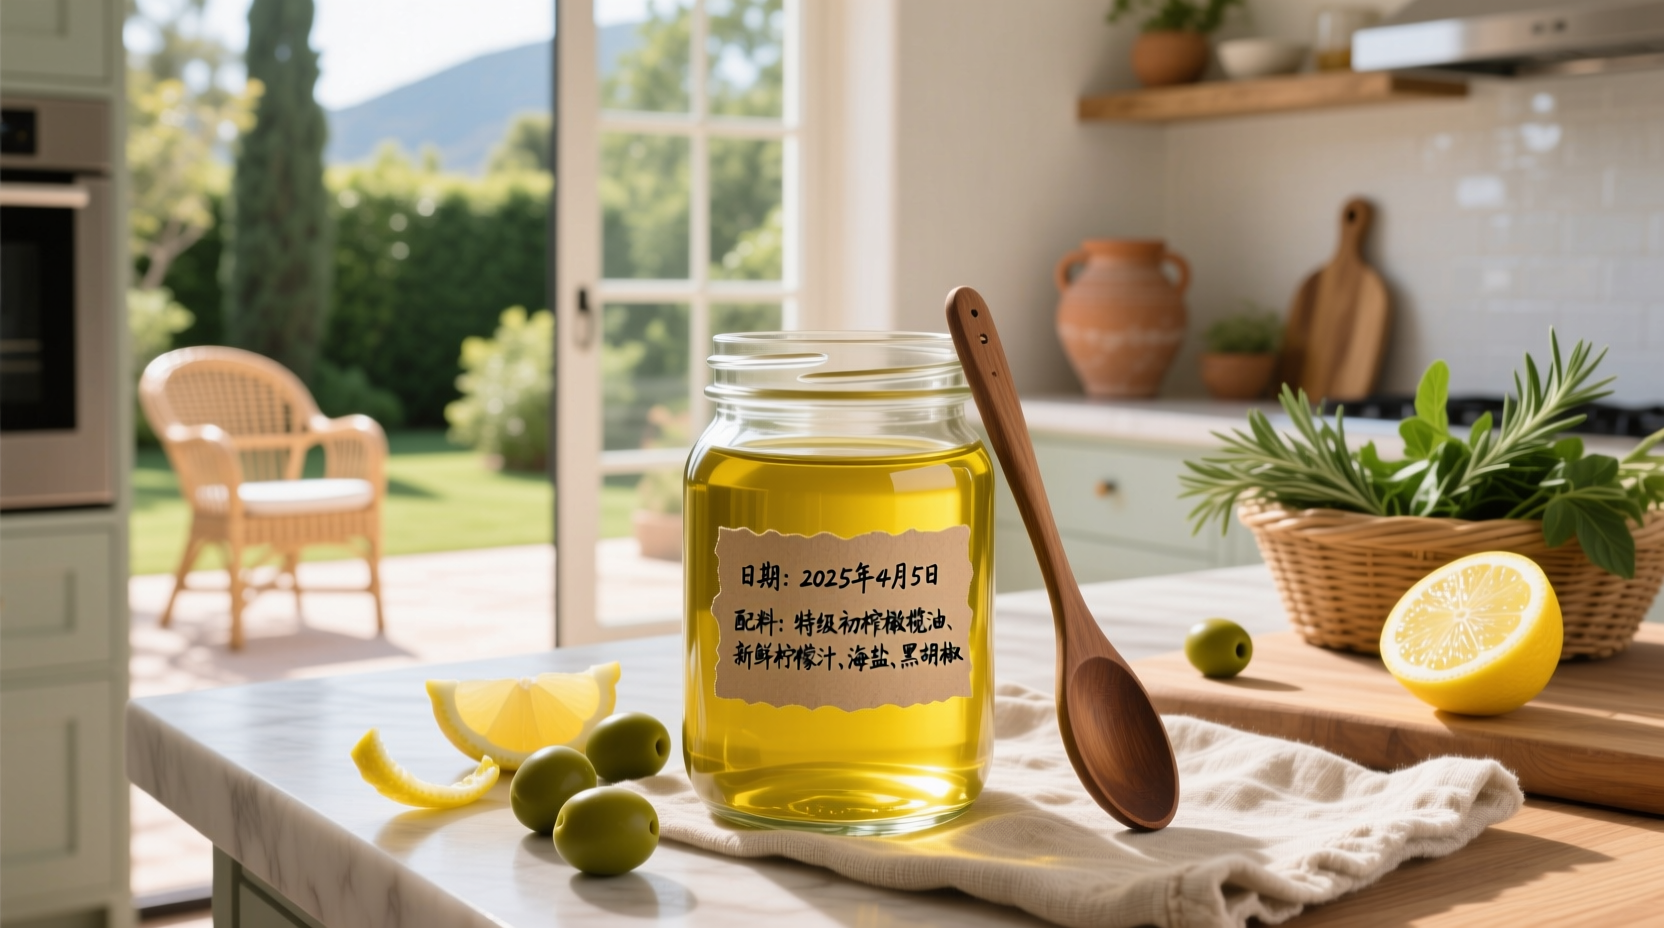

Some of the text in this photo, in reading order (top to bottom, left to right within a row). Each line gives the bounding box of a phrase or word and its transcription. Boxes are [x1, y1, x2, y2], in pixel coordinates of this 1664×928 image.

[733, 640, 963, 672] 新鲜柠檬汁、海盐、黑胡椒
